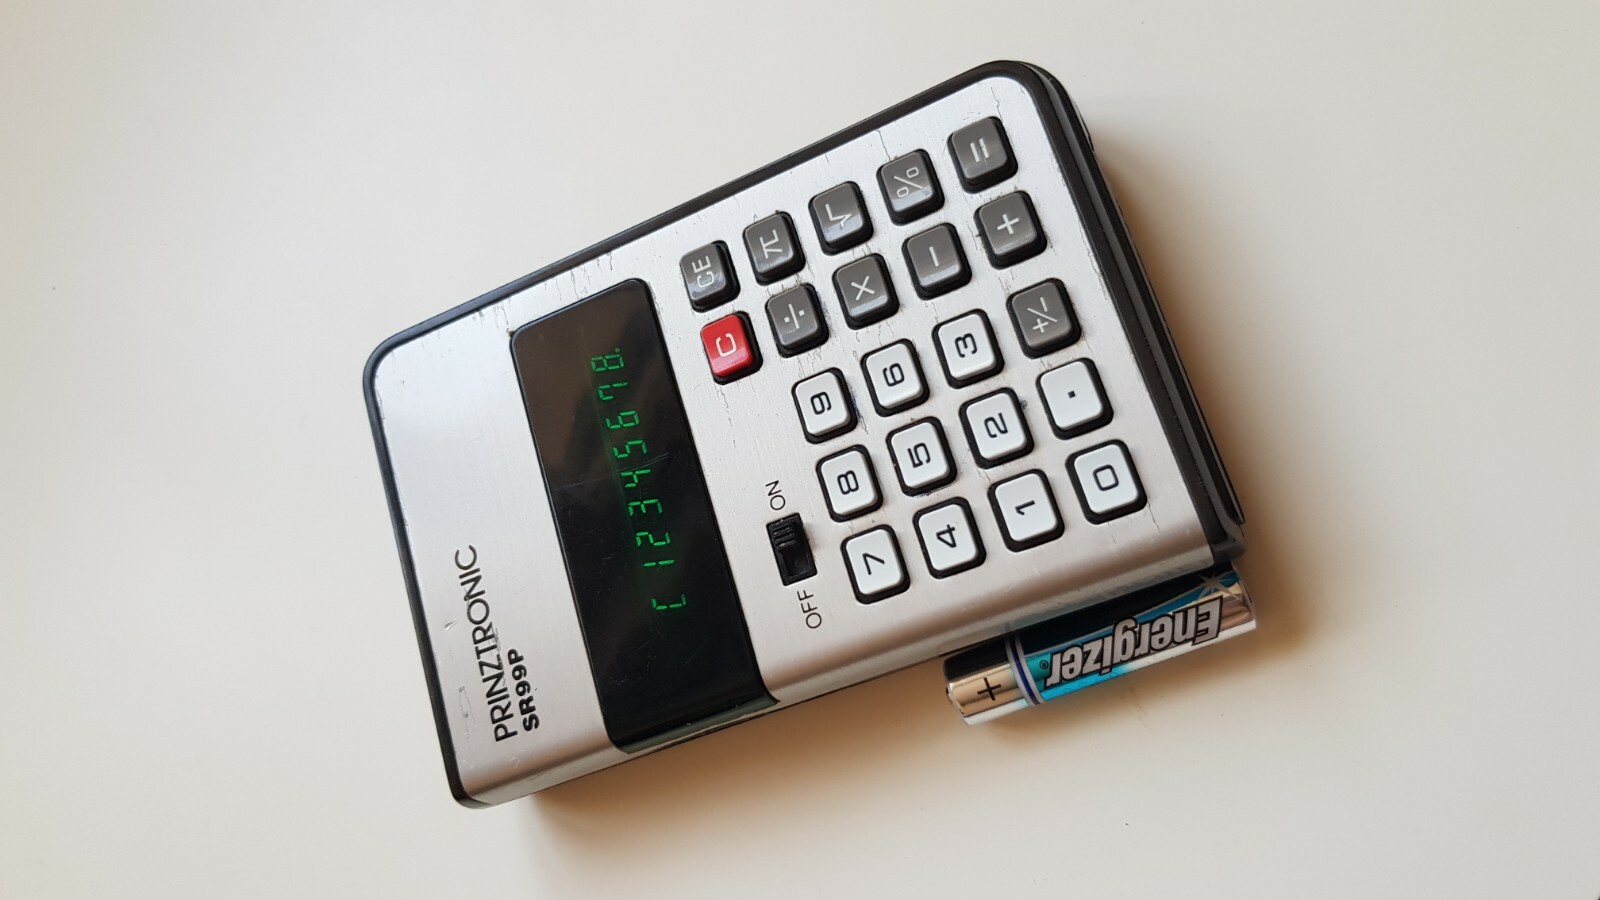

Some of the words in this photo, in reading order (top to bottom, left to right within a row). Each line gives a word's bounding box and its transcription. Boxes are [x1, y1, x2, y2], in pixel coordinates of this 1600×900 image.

[692, 255, 711, 290] CE
[715, 333, 738, 358] C
[954, 332, 978, 358] 3
[882, 362, 905, 387] 6
[810, 391, 832, 415] 9
[983, 412, 1009, 439] 2
[907, 442, 931, 469] 5
[765, 480, 786, 511] ON
[836, 470, 860, 495] 8
[1015, 500, 1036, 516] 1
[935, 524, 957, 549] 4
[862, 552, 885, 576] 7
[796, 590, 822, 629] OFF
[454, 545, 519, 743] PRINZTRONIC
[507, 648, 540, 733] SR99P
